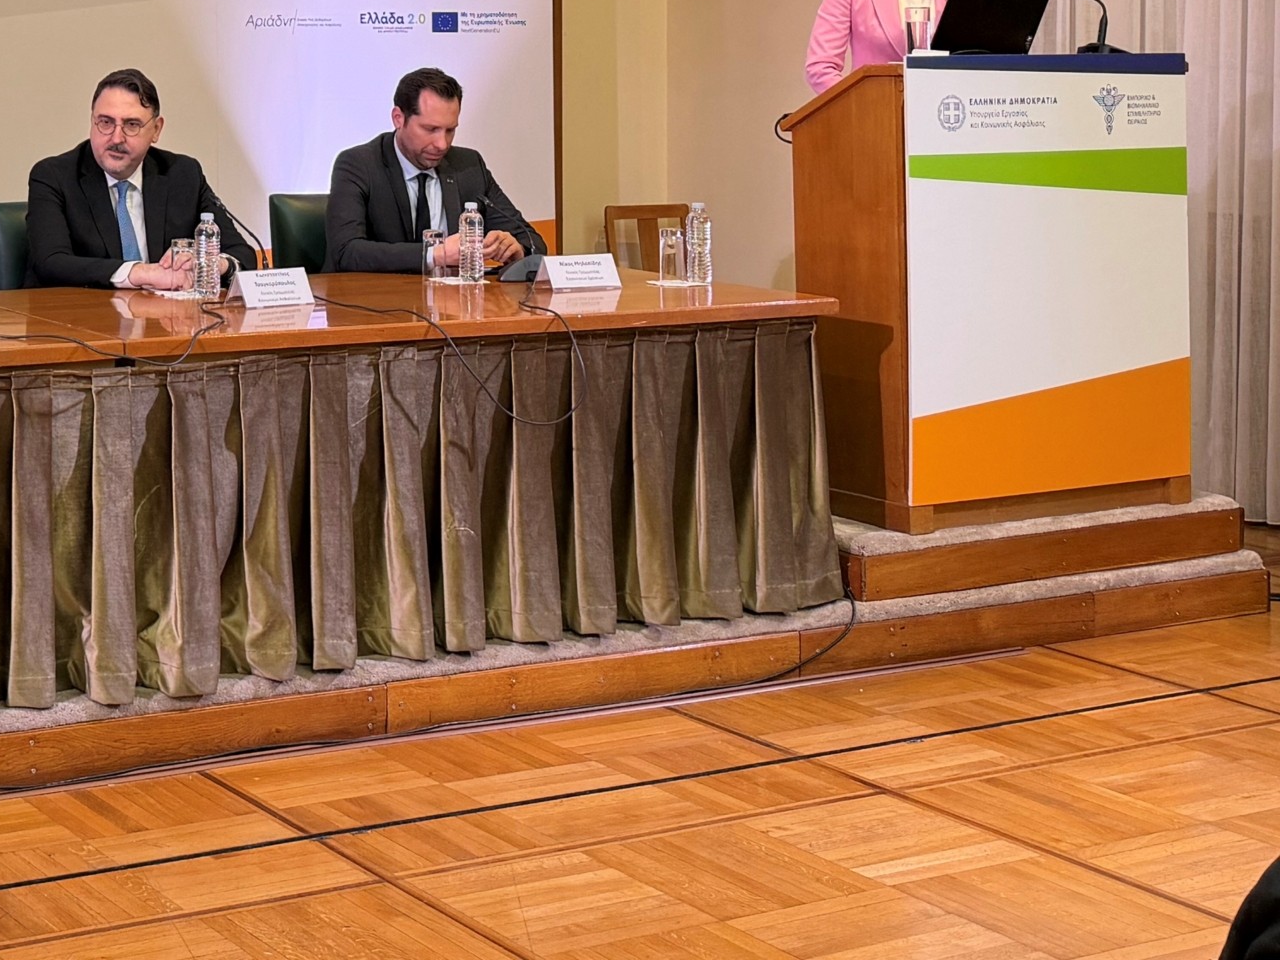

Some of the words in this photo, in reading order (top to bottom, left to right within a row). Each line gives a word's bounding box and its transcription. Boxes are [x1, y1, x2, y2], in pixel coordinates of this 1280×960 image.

[360, 12, 404, 25] Ελλάδα
[408, 13, 426, 24] 2.0
[1009, 97, 1058, 105] ΔΗΜΟΚΡΑΤΙΑ
